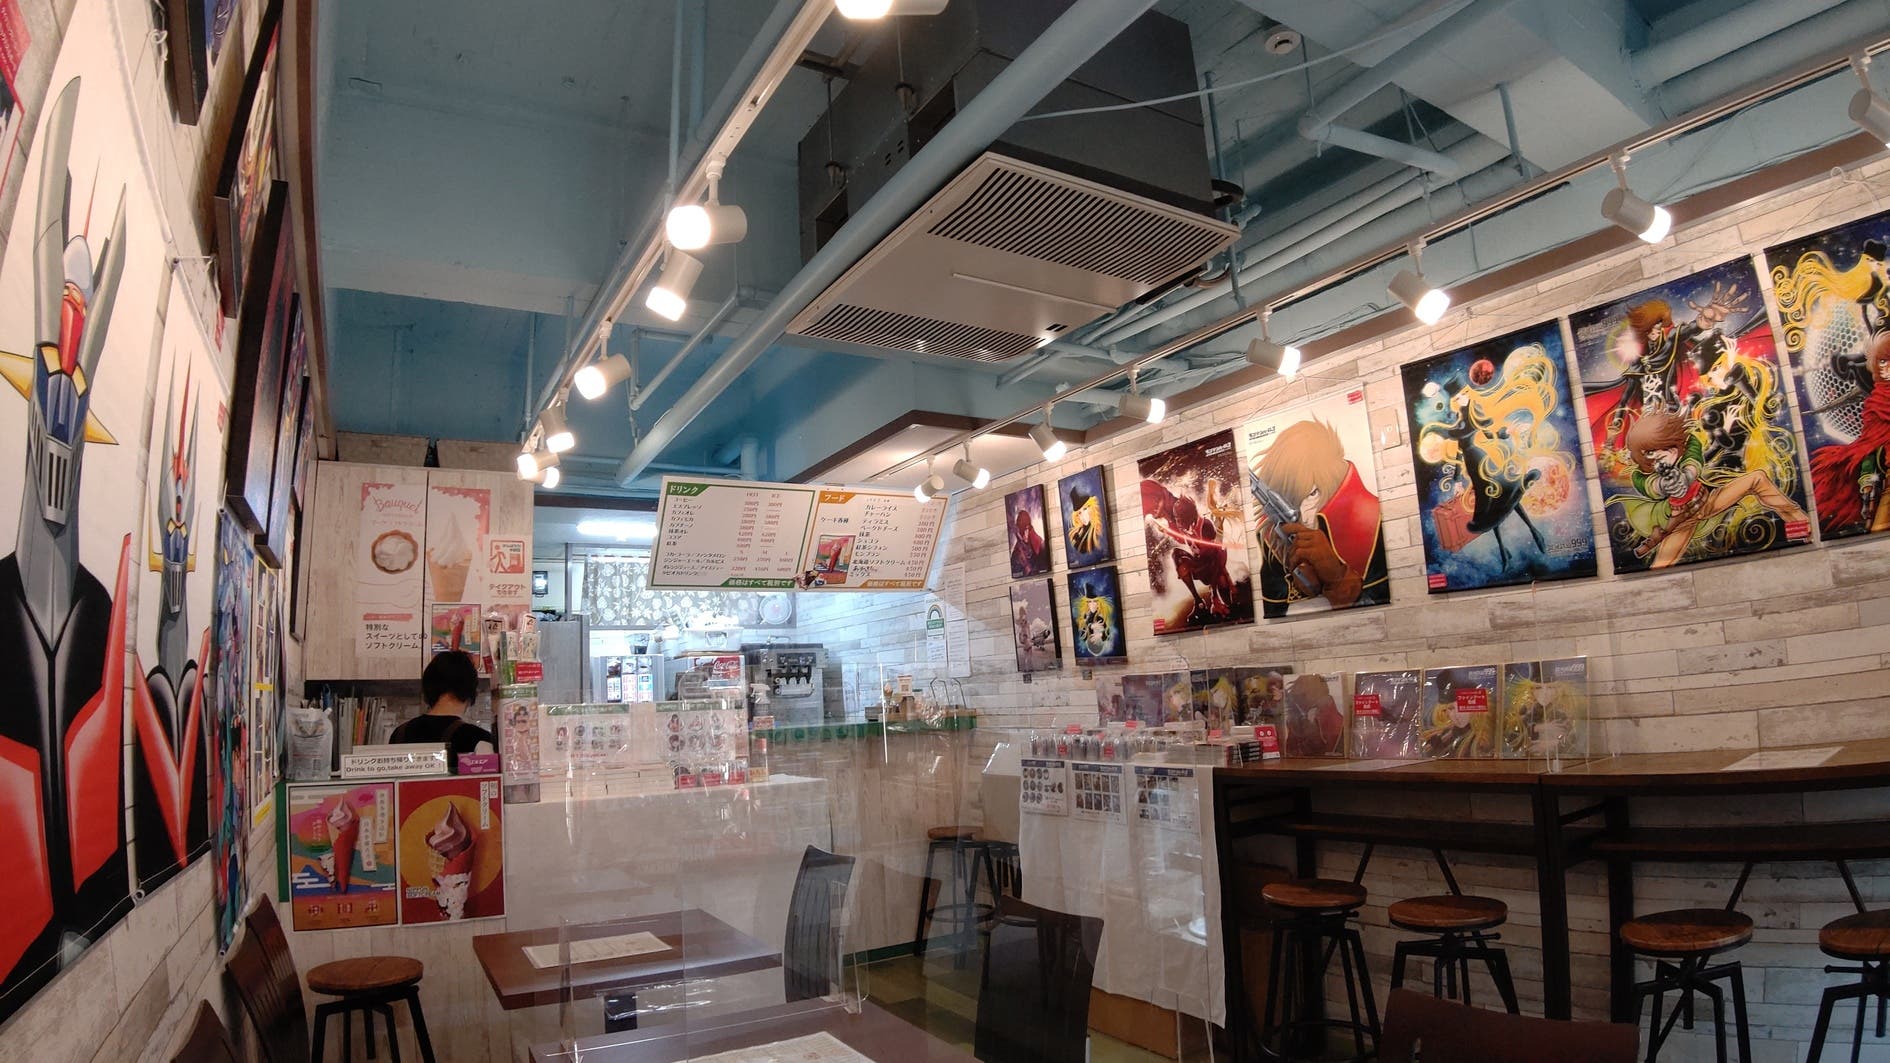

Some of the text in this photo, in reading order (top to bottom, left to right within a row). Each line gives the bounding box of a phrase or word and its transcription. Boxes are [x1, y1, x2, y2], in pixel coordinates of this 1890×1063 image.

[669, 484, 699, 495] ドリンク
[366, 632, 429, 640] スイーツとしての
